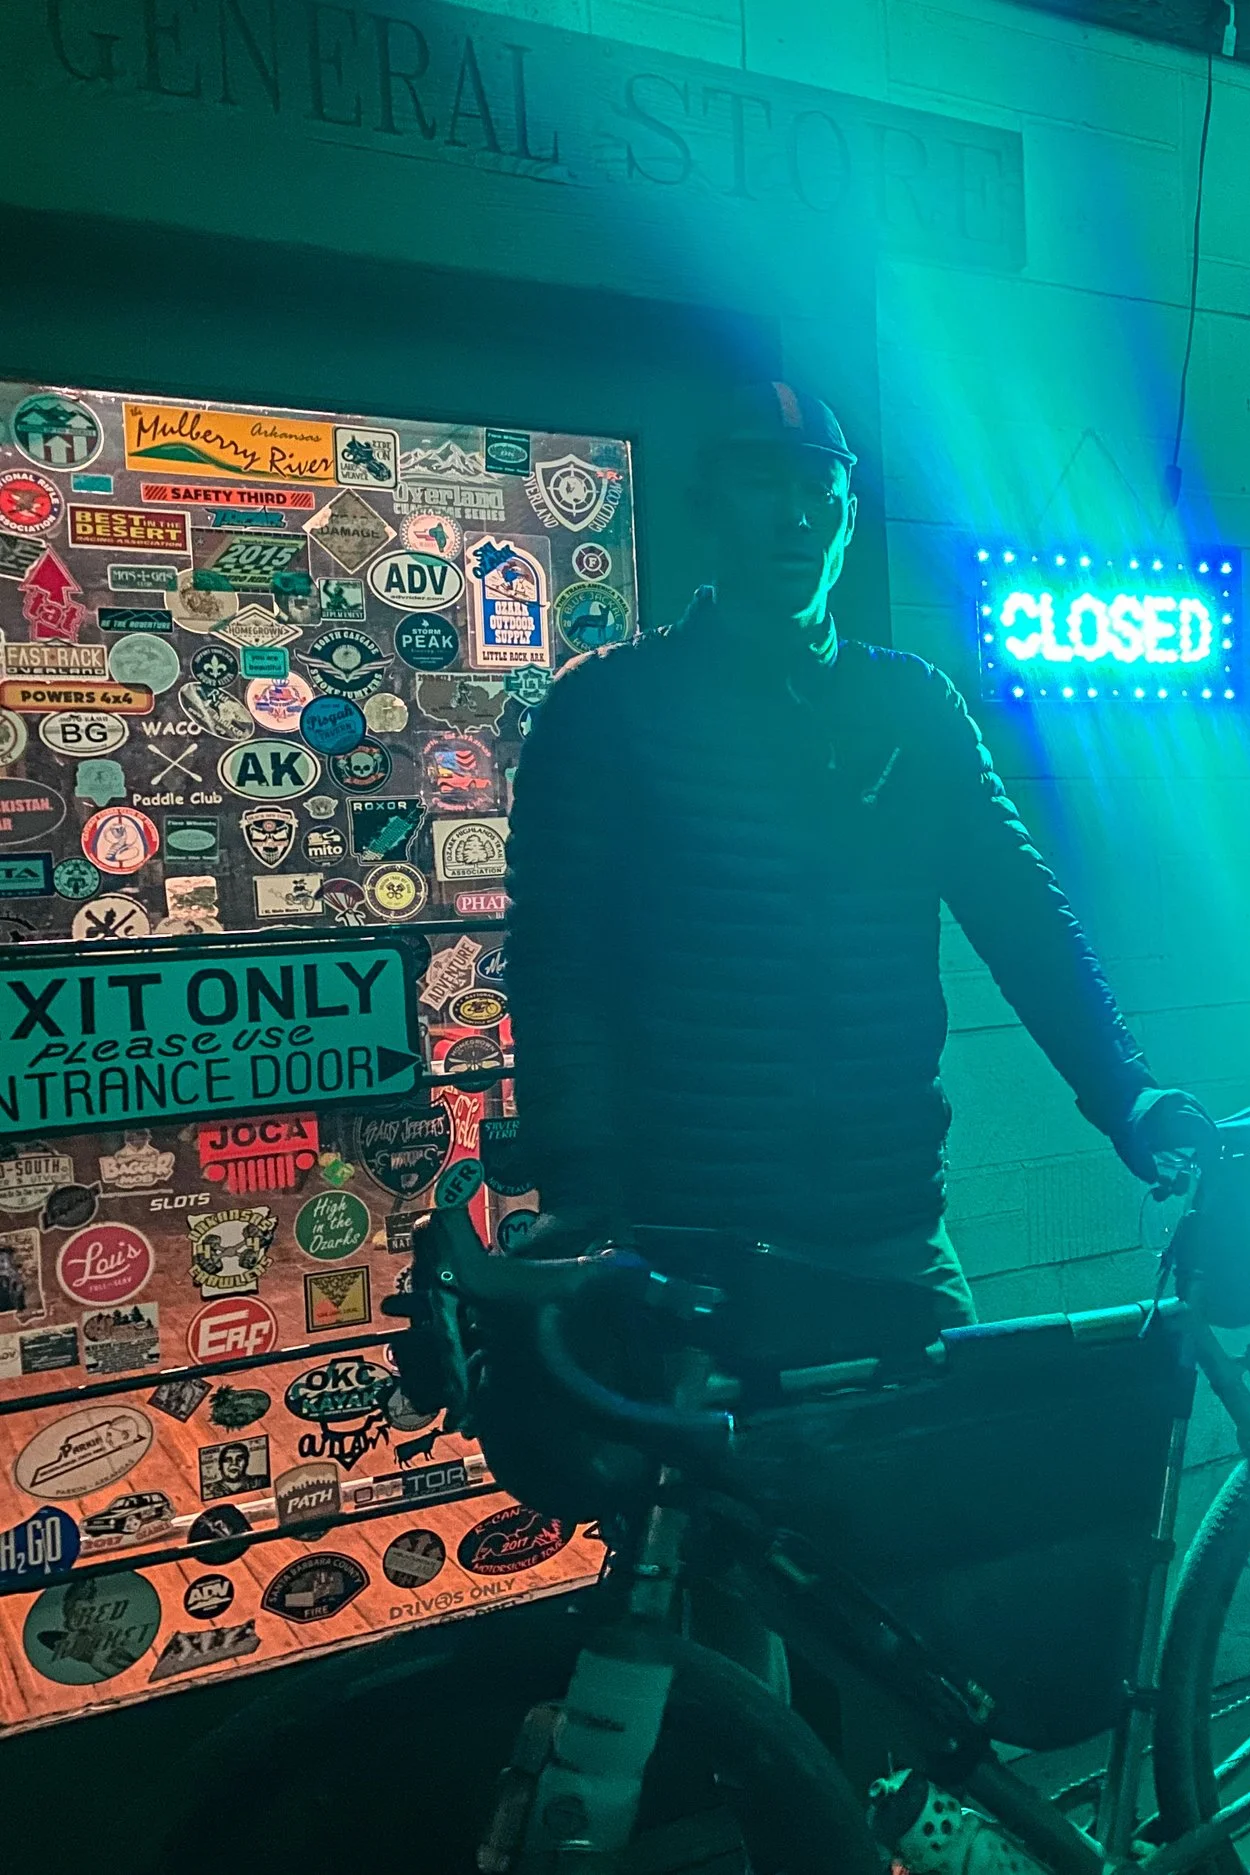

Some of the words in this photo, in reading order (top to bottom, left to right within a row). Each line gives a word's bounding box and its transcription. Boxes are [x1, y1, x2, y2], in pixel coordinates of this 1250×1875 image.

[48, 0, 560, 164] GENERAL
[622, 72, 1004, 245] STORE
[250, 422, 322, 443] Arkansas
[136, 411, 260, 471] Mulberry
[268, 447, 335, 480] River
[377, 449, 390, 460] ON
[37, 478, 59, 504] RIFLE
[171, 487, 233, 503] SAFETY
[237, 491, 287, 505] THIRD
[393, 480, 505, 510] Overland
[522, 471, 559, 529] OVERLAND
[75, 511, 146, 525] BEST
[465, 508, 505, 521] SERIES
[75, 523, 182, 541] DESERT
[76, 536, 113, 544] RACING
[117, 539, 182, 548] ASSOCIATION
[320, 526, 380, 539] DAMAGE
[219, 544, 297, 566] 2015
[588, 557, 597, 567] F
[384, 562, 449, 596] ADV
[390, 594, 446, 602] advrider.com
[564, 594, 587, 614] BLUE
[495, 601, 529, 617] OZARK
[229, 626, 284, 637] HOMEGROWN
[490, 616, 535, 630] OUTDOOR
[1000, 592, 1213, 663] CLOSED
[314, 632, 342, 651] NORTH
[343, 631, 380, 654] CASCADE
[402, 635, 453, 649] PEAK
[495, 630, 531, 645] SUPPLY
[7, 647, 50, 667] FAST
[482, 651, 507, 662] LITTLE
[7, 667, 104, 675] OVERLAND
[343, 673, 383, 699] JUMPERS
[21, 691, 95, 704] POWERS
[101, 692, 133, 705] 4x4
[60, 724, 108, 744] BG
[141, 721, 201, 737] WACO
[235, 752, 305, 787] AK
[133, 793, 184, 806] Paddle
[190, 791, 223, 804] Club
[353, 801, 407, 811] ROXOR
[308, 844, 343, 857] mito
[446, 836, 456, 862] OZARK
[456, 827, 496, 842] HIGHLANDS
[451, 868, 502, 876] ASSOCIATION
[428, 943, 476, 1002] ADVENTURE
[6, 973, 162, 1041] XIT
[186, 959, 389, 1028] ONLY
[231, 1023, 315, 1052] use
[452, 1040, 496, 1057] HOMEGROWN
[0, 1057, 232, 1123] NTRANCE
[252, 1045, 374, 1097] DOOR
[209, 1119, 309, 1150] JOCA
[485, 1121, 520, 1130] SILVER
[488, 1130, 517, 1139] FERN
[105, 1152, 173, 1178] BAGGER
[150, 1193, 211, 1211] SLOTS
[313, 1195, 347, 1220] High
[188, 1209, 277, 1242] ARKANSAS
[312, 1220, 324, 1234] in
[330, 1214, 353, 1229] the
[309, 1228, 361, 1253] Ozarks
[67, 1241, 141, 1287] Lou's
[189, 1256, 274, 1289] CRAWLERS
[306, 1366, 376, 1390] OKC
[60, 1436, 103, 1458] PARKIN
[287, 1488, 333, 1514] PATH
[501, 1537, 529, 1553] 2017
[541, 1541, 564, 1559] TOUR
[268, 1578, 291, 1603] SANTA
[290, 1558, 331, 1577] BARBARA
[332, 1558, 362, 1583] COUNTY
[470, 1578, 516, 1600] ONLY
[188, 1581, 229, 1604] ADV
[304, 1605, 329, 1618] FIRE
